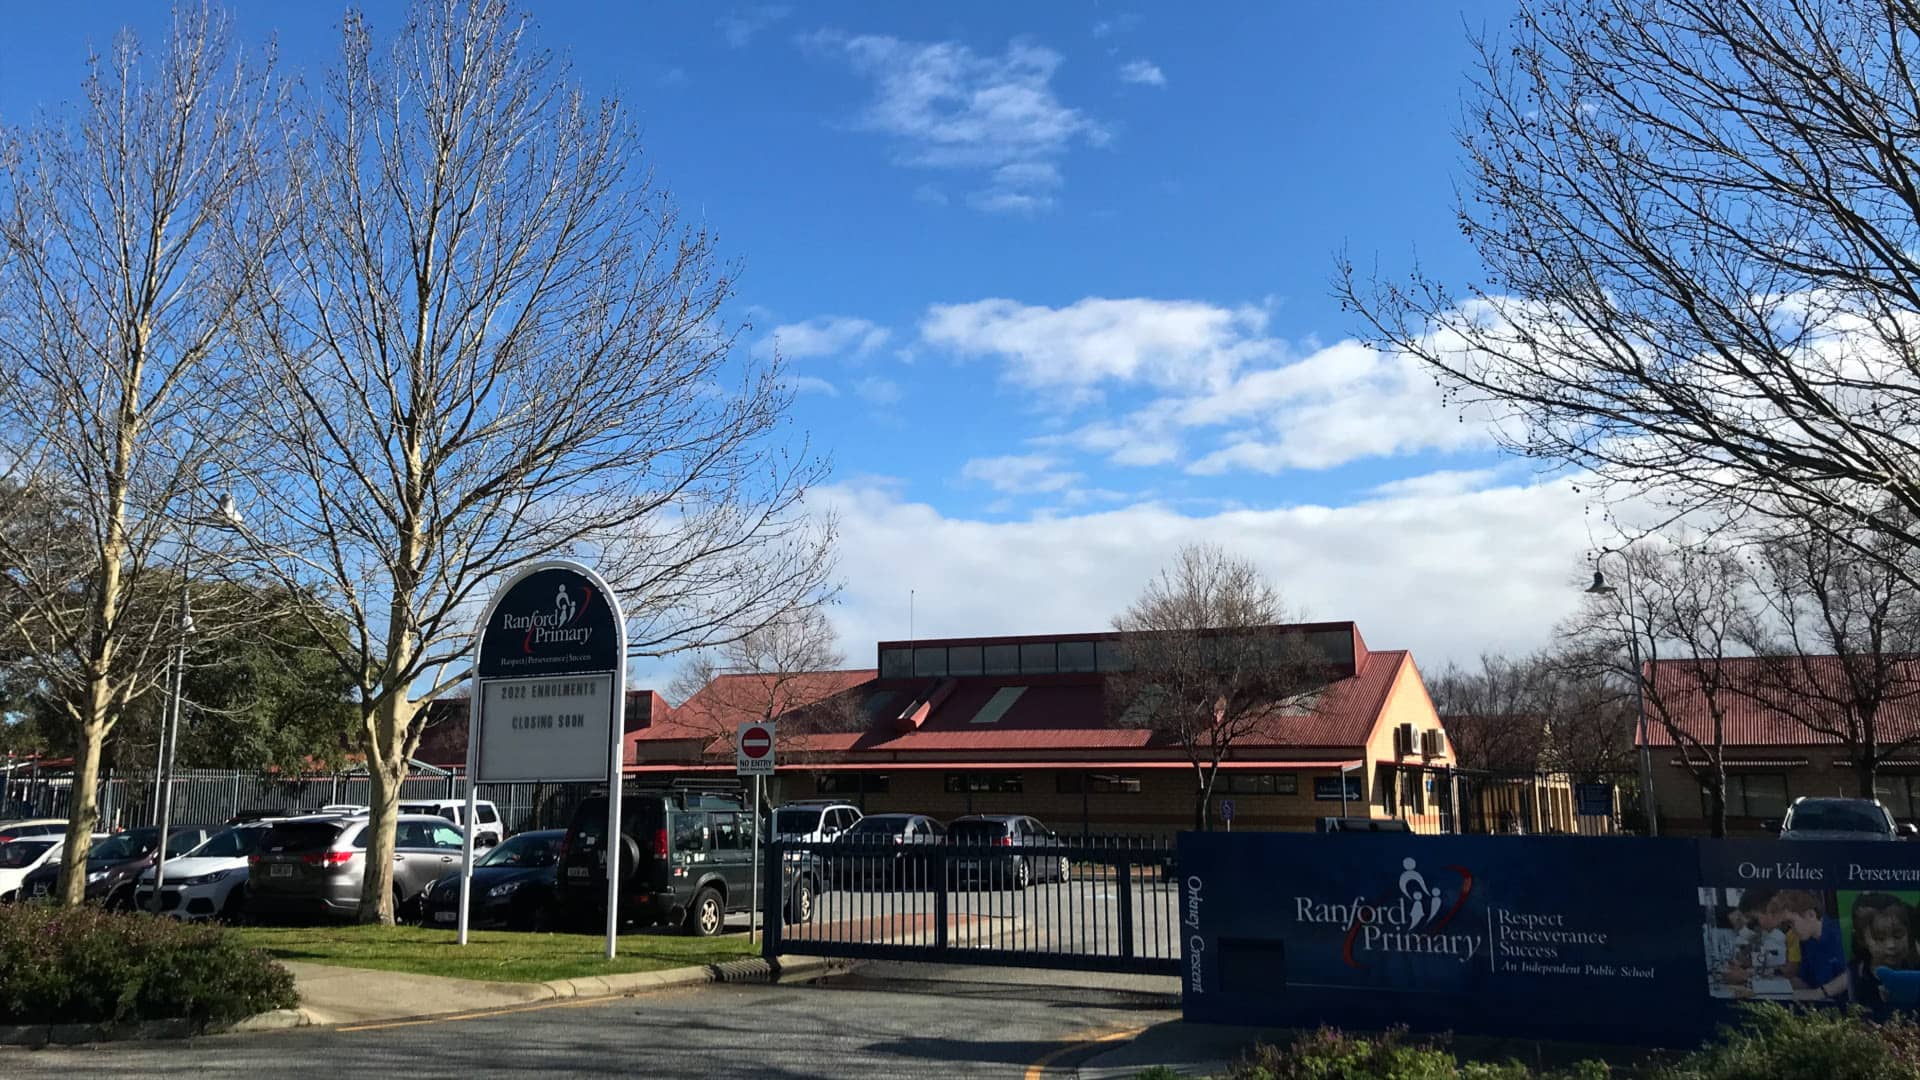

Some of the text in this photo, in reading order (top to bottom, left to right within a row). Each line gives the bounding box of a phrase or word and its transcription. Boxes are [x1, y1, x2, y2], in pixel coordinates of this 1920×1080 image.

[503, 609, 559, 633] Ranford
[535, 626, 593, 645] Primary
[501, 682, 596, 700] 2022 ENROLMENTS
[511, 713, 585, 730] CLOSING SOON
[739, 759, 772, 767] NO ENTRY
[1738, 861, 1824, 880] Our Values
[1294, 896, 1408, 931] Ranford
[1499, 908, 1564, 931] Respect
[1362, 924, 1482, 962] Primary
[1499, 925, 1607, 945] Perseverance
[1498, 940, 1559, 959] Success
[1190, 934, 1205, 994] Crescent
[1501, 961, 1655, 979] An Independent Public School
